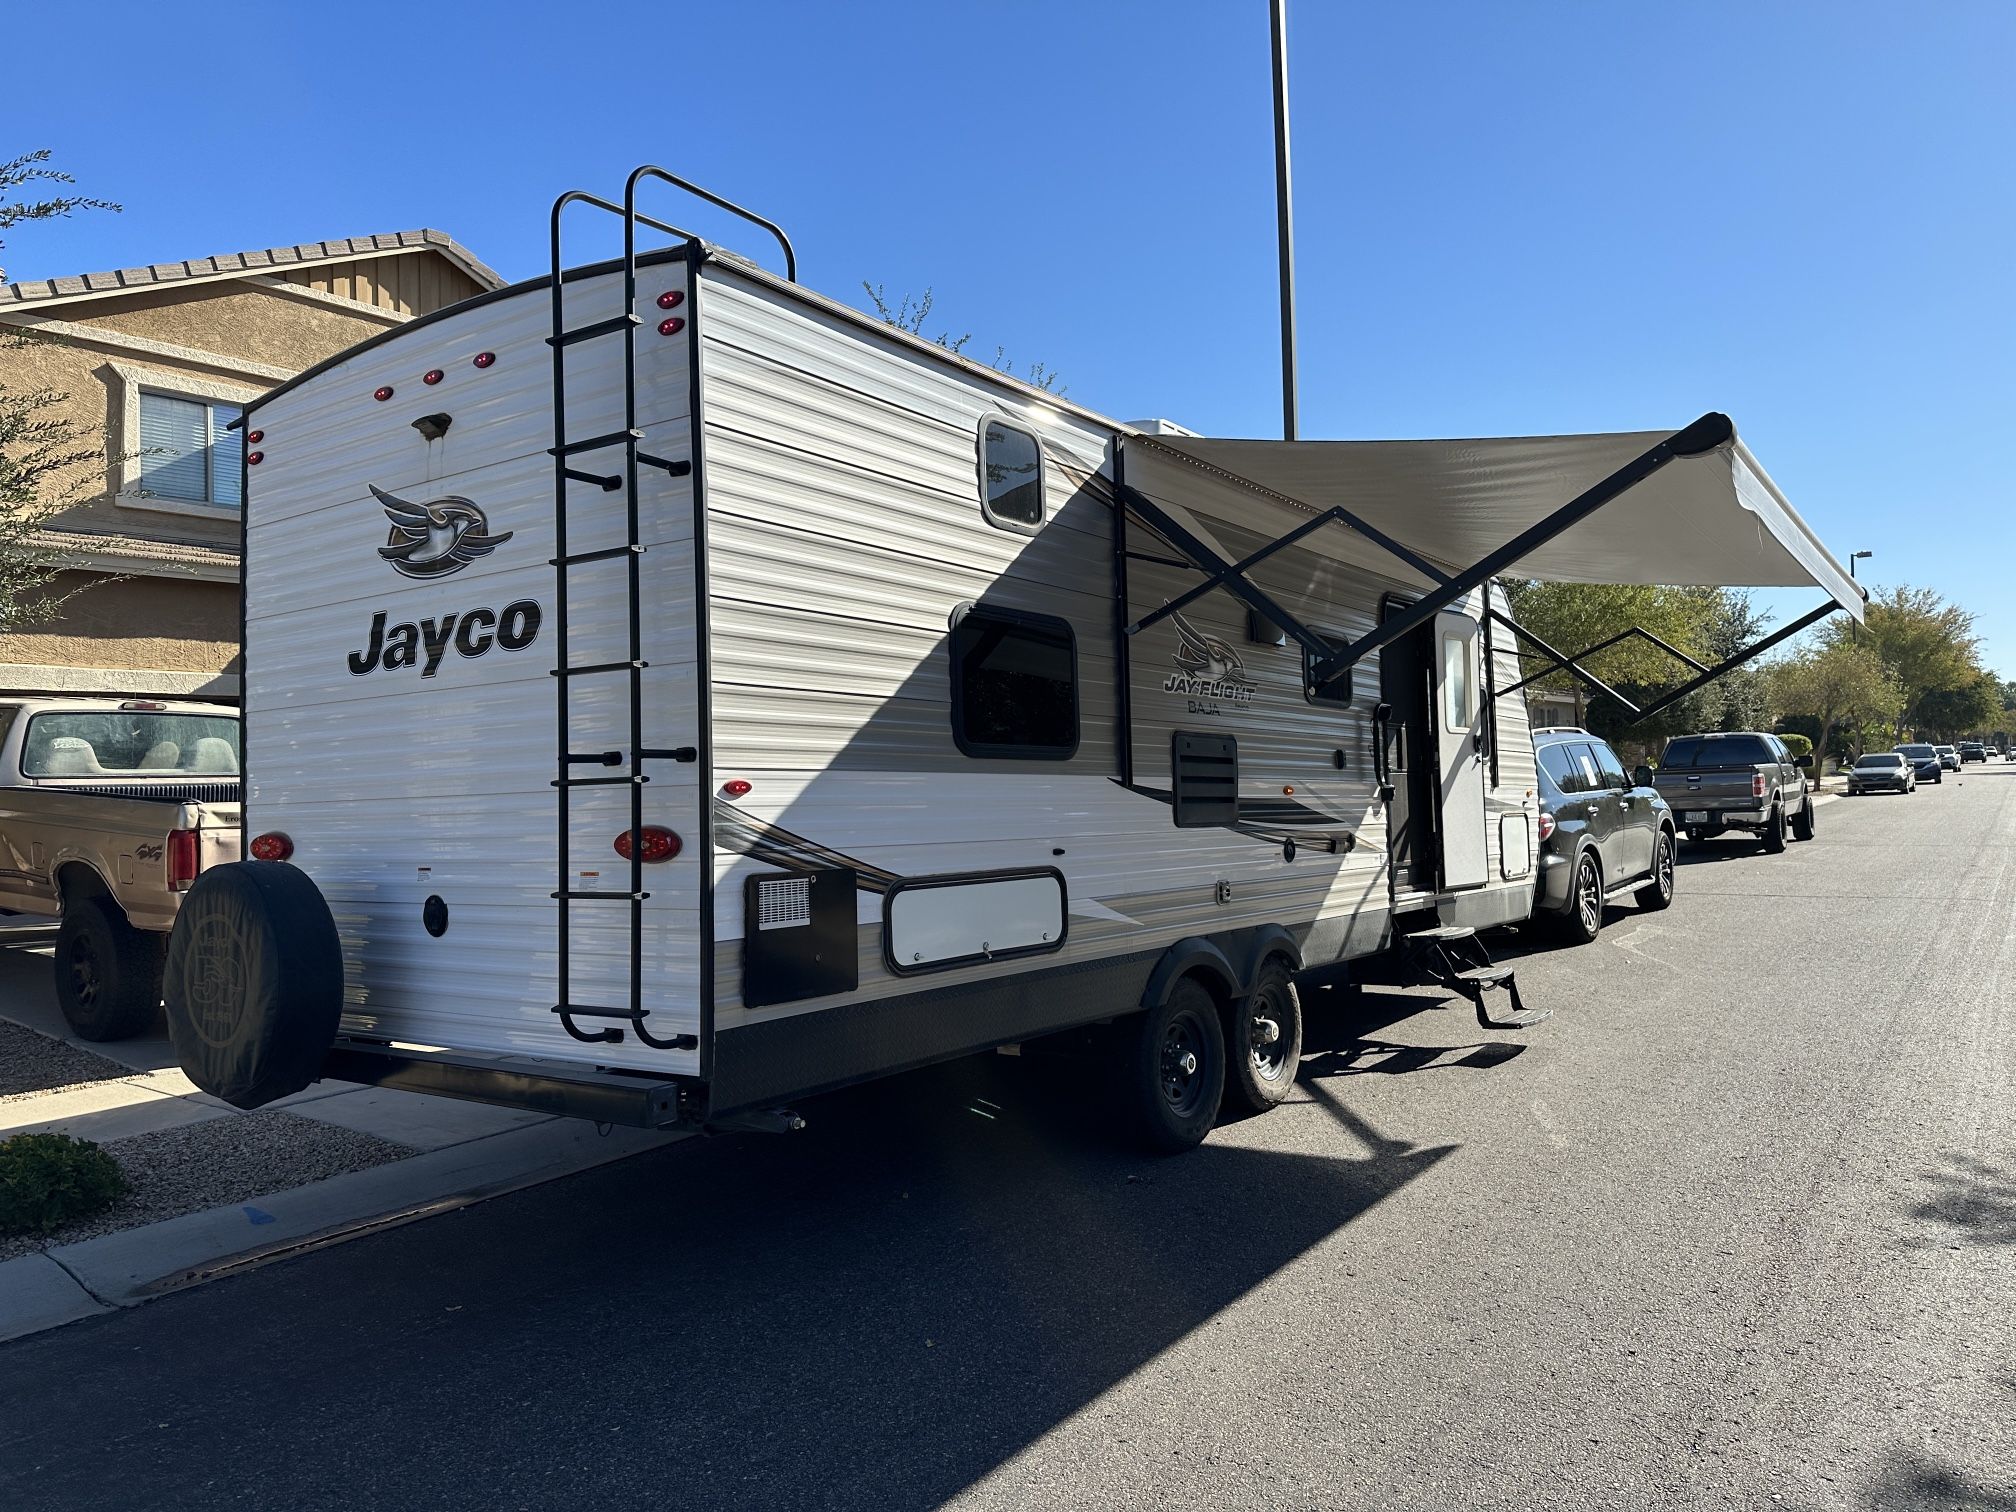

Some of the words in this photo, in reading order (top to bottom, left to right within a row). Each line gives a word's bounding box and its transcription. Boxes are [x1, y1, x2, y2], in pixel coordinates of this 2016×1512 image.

[347, 598, 543, 679] Jayco
[1163, 673, 1198, 695] JAY
[1199, 679, 1256, 701] FLIGHT
[1188, 700, 1220, 716] BAJA
